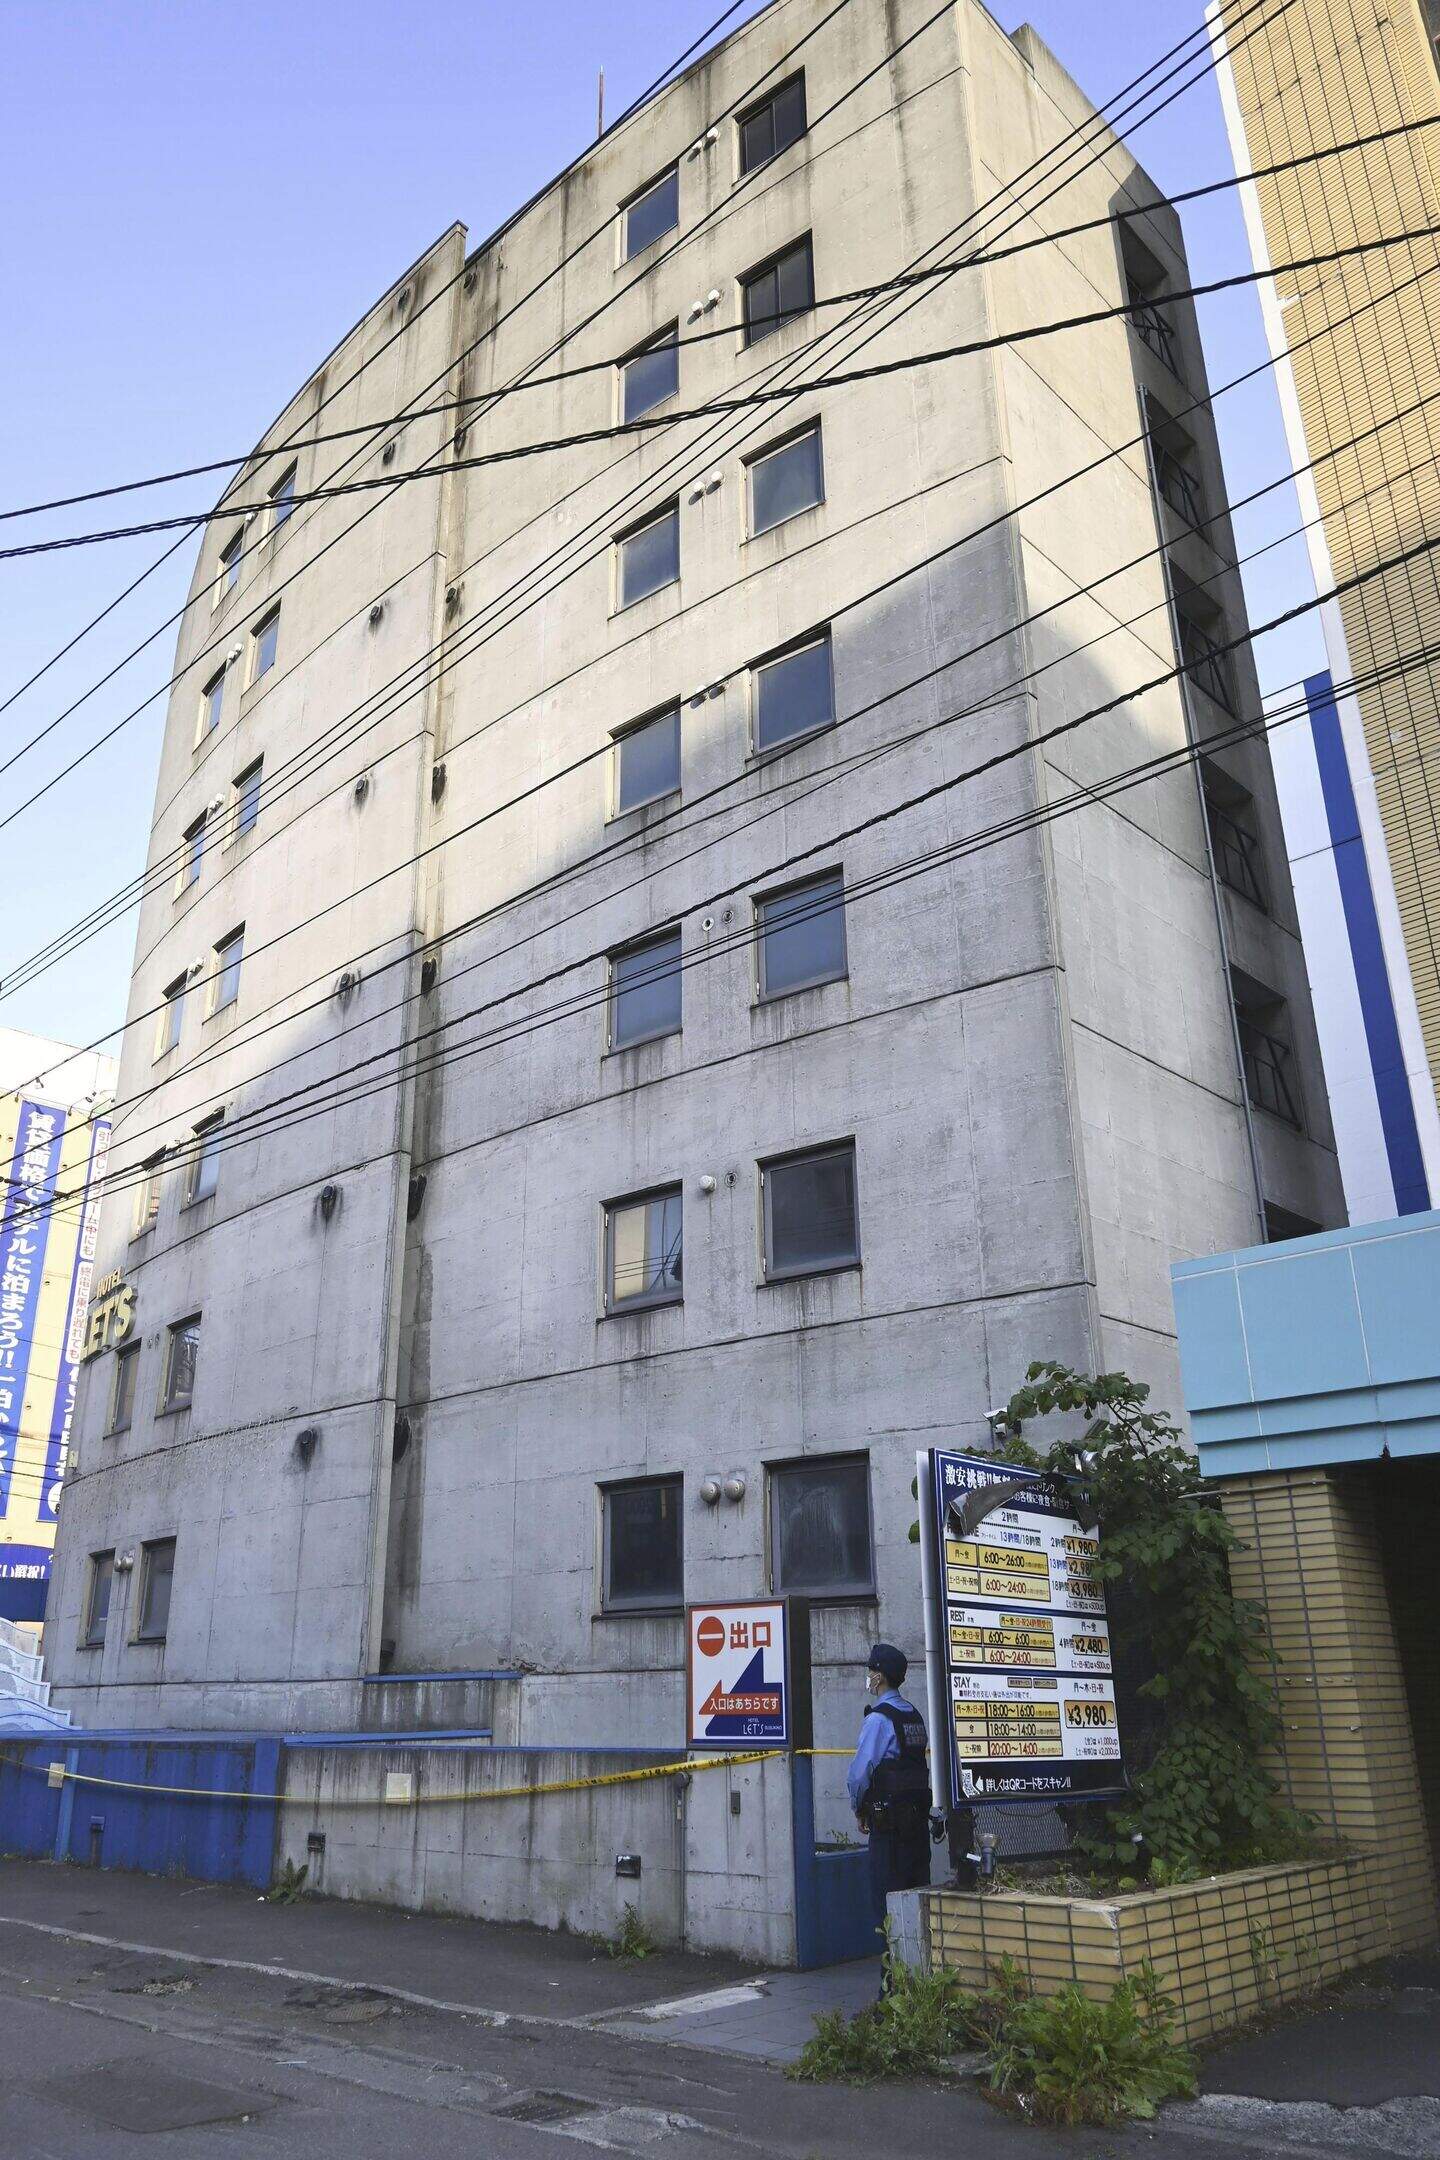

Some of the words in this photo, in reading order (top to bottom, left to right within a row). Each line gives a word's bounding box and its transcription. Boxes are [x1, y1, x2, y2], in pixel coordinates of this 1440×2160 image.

[1001, 1511, 1019, 1524] 2時間
[999, 1531, 1042, 1547] 13時間/18時間
[950, 1611, 966, 1623] REST
[730, 1621, 771, 1650] 出口
[953, 1677, 971, 1689] STAY
[709, 1696, 779, 1712] 入口はあちらです
[742, 1722, 765, 1735] LET'S
